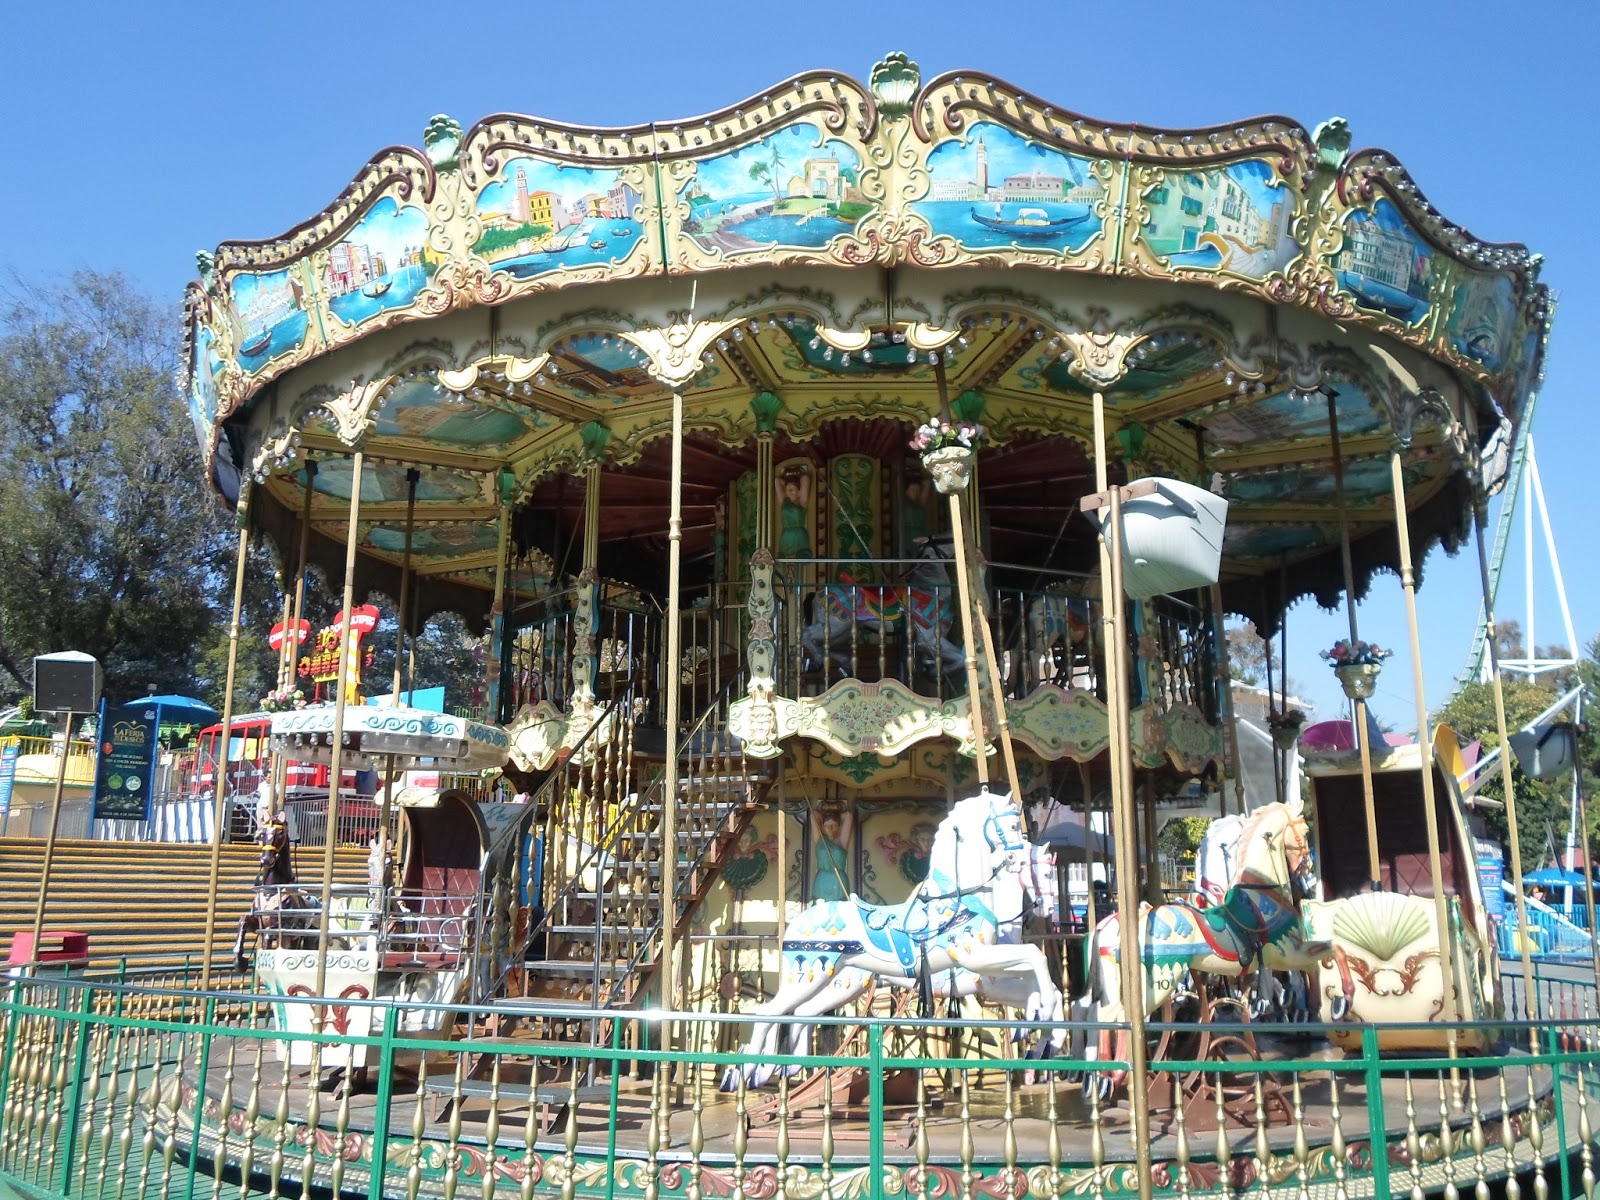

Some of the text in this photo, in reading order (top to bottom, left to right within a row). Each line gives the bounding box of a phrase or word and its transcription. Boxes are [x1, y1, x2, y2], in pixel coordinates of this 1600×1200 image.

[796, 972, 805, 983] 7
[833, 979, 842, 989] 6
[1155, 979, 1170, 990] 10
